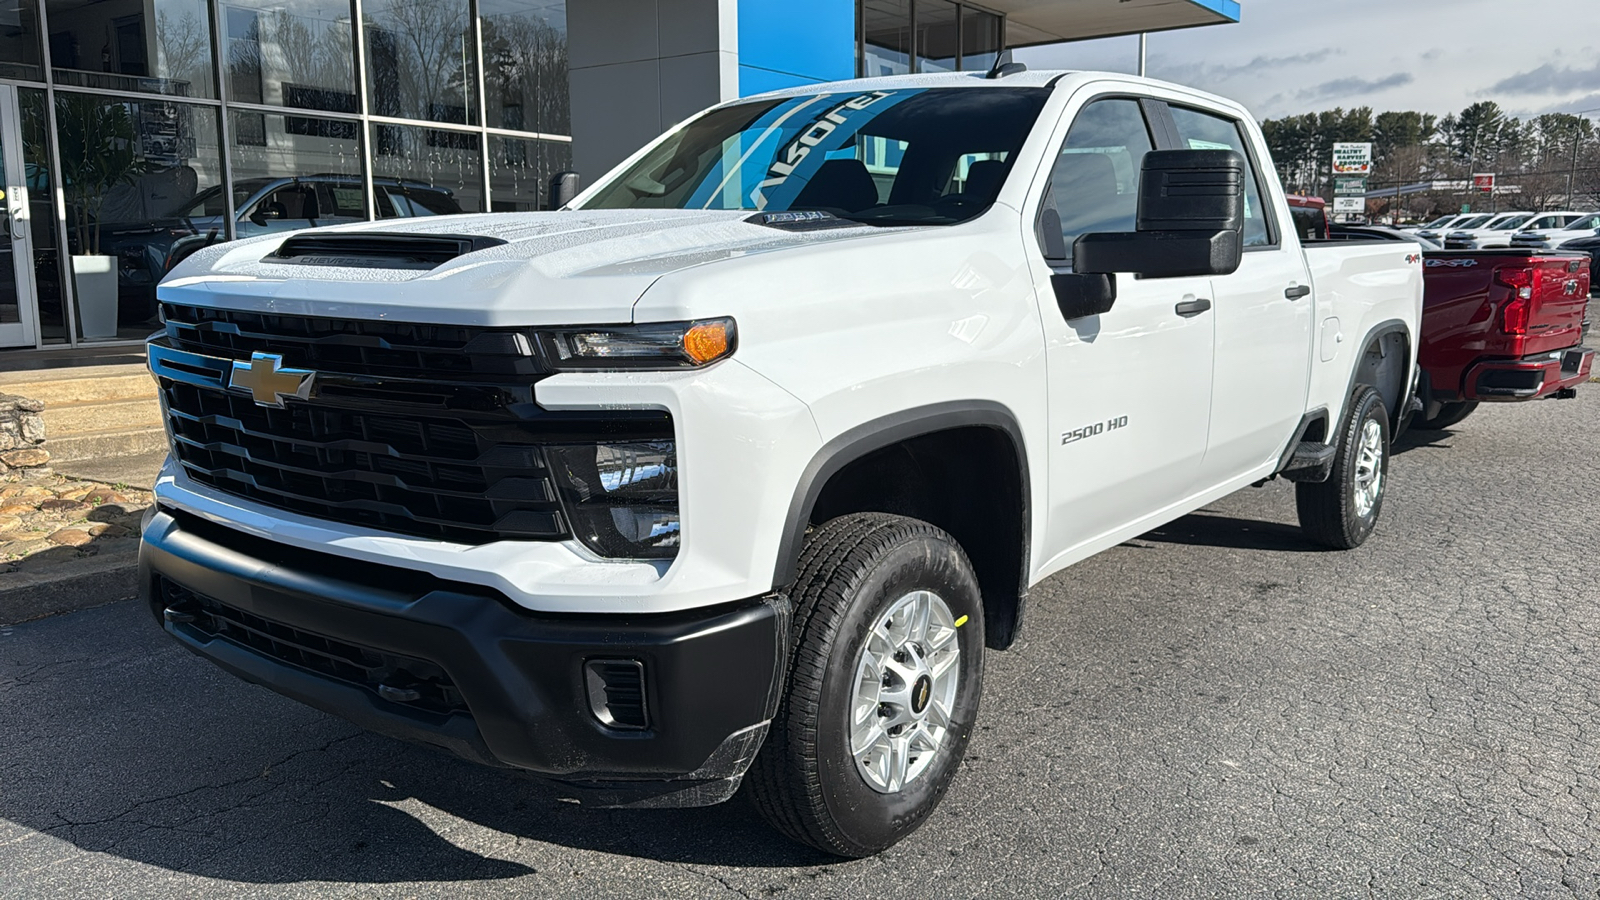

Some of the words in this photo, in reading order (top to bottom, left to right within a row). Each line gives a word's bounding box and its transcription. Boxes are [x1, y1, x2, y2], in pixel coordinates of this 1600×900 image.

[300, 257, 386, 266] CHEVROLET
[1061, 422, 1103, 446] 2500
[1107, 415, 1128, 432] HD
